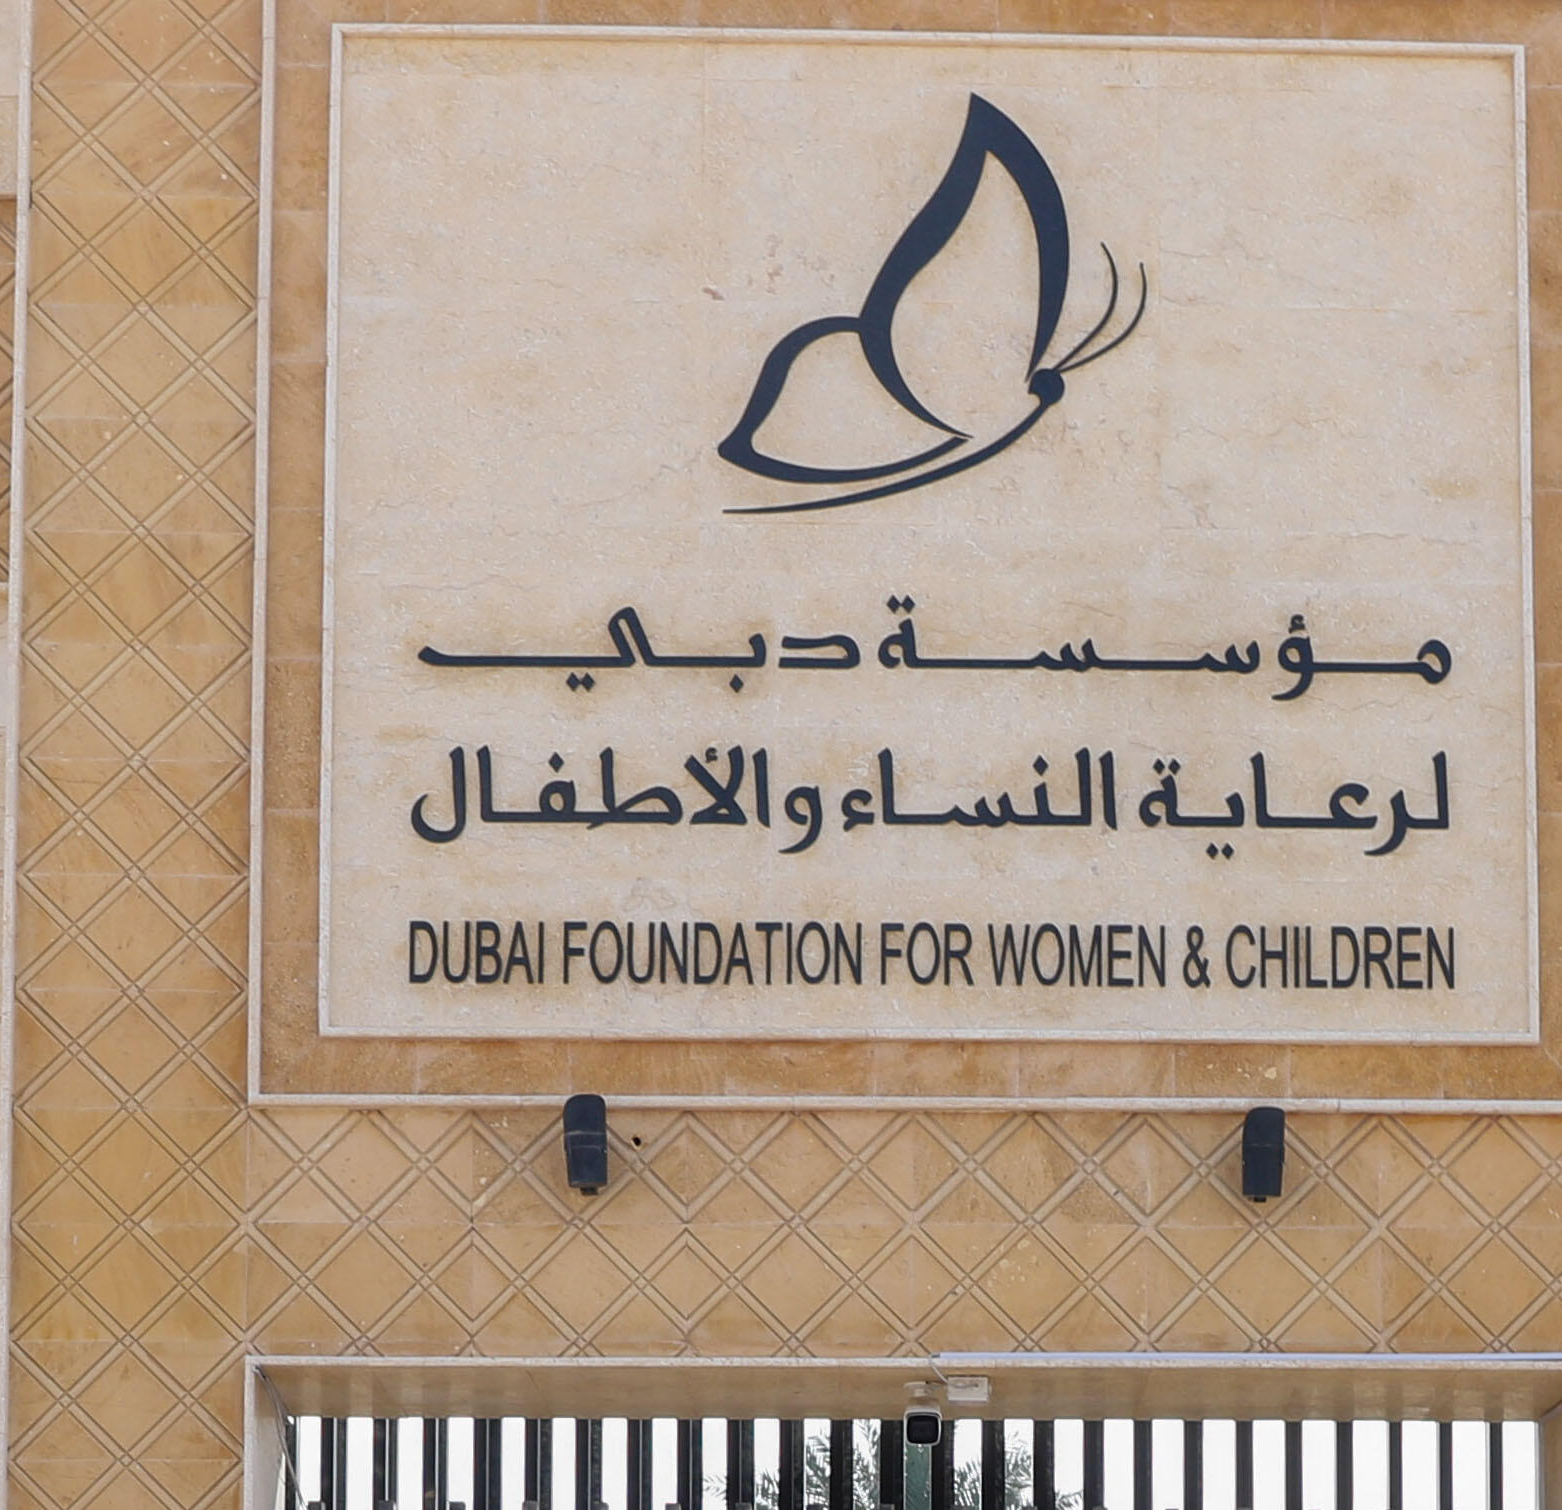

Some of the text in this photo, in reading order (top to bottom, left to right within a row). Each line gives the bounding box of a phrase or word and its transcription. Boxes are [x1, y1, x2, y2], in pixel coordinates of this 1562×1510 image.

[417, 595, 1452, 701] مؤسسة دبي
[410, 745, 1450, 860] لرعاية النساء والأطفال
[409, 920, 1455, 990] DUBAI FOUNDATION FOR WOMEN & CHILDREN
